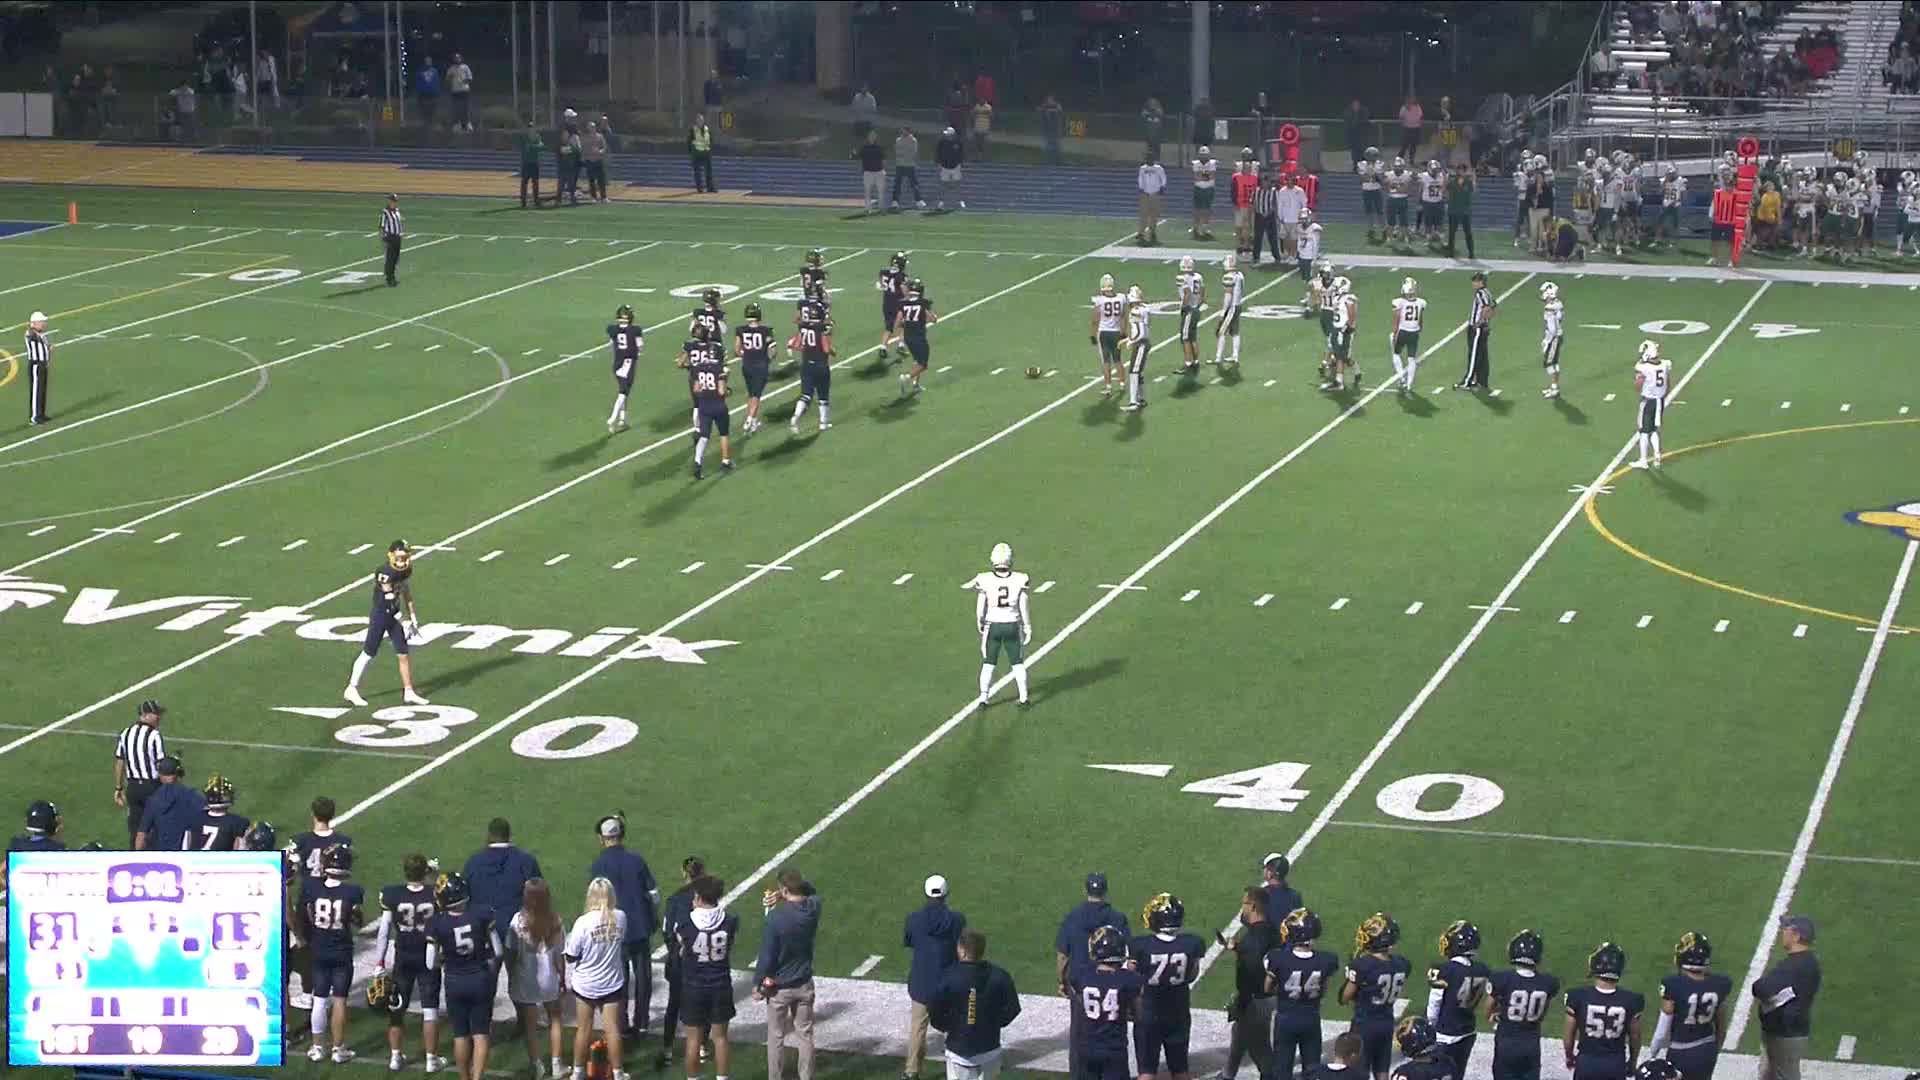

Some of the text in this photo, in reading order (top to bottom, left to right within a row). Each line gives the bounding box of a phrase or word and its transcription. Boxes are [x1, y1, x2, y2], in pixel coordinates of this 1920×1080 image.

[903, 304, 922, 322] 77
[1103, 301, 1122, 317] 99
[1404, 305, 1419, 321] 21
[617, 333, 628, 350] 9
[742, 332, 764, 351] 50
[800, 328, 817, 347] 70
[1655, 370, 1665, 388] 5
[997, 585, 1009, 608] 2
[62, 586, 741, 665] Vitamix
[202, 825, 219, 850] 7
[314, 898, 344, 930] 81
[454, 924, 474, 955] 5
[692, 930, 728, 962] 48
[1148, 952, 1188, 986] 73
[1284, 970, 1322, 999] 44
[1083, 986, 1119, 1021] 64
[1507, 990, 1548, 1022] 80
[1683, 991, 1719, 1025] 13
[1585, 1004, 1626, 1040] 53
